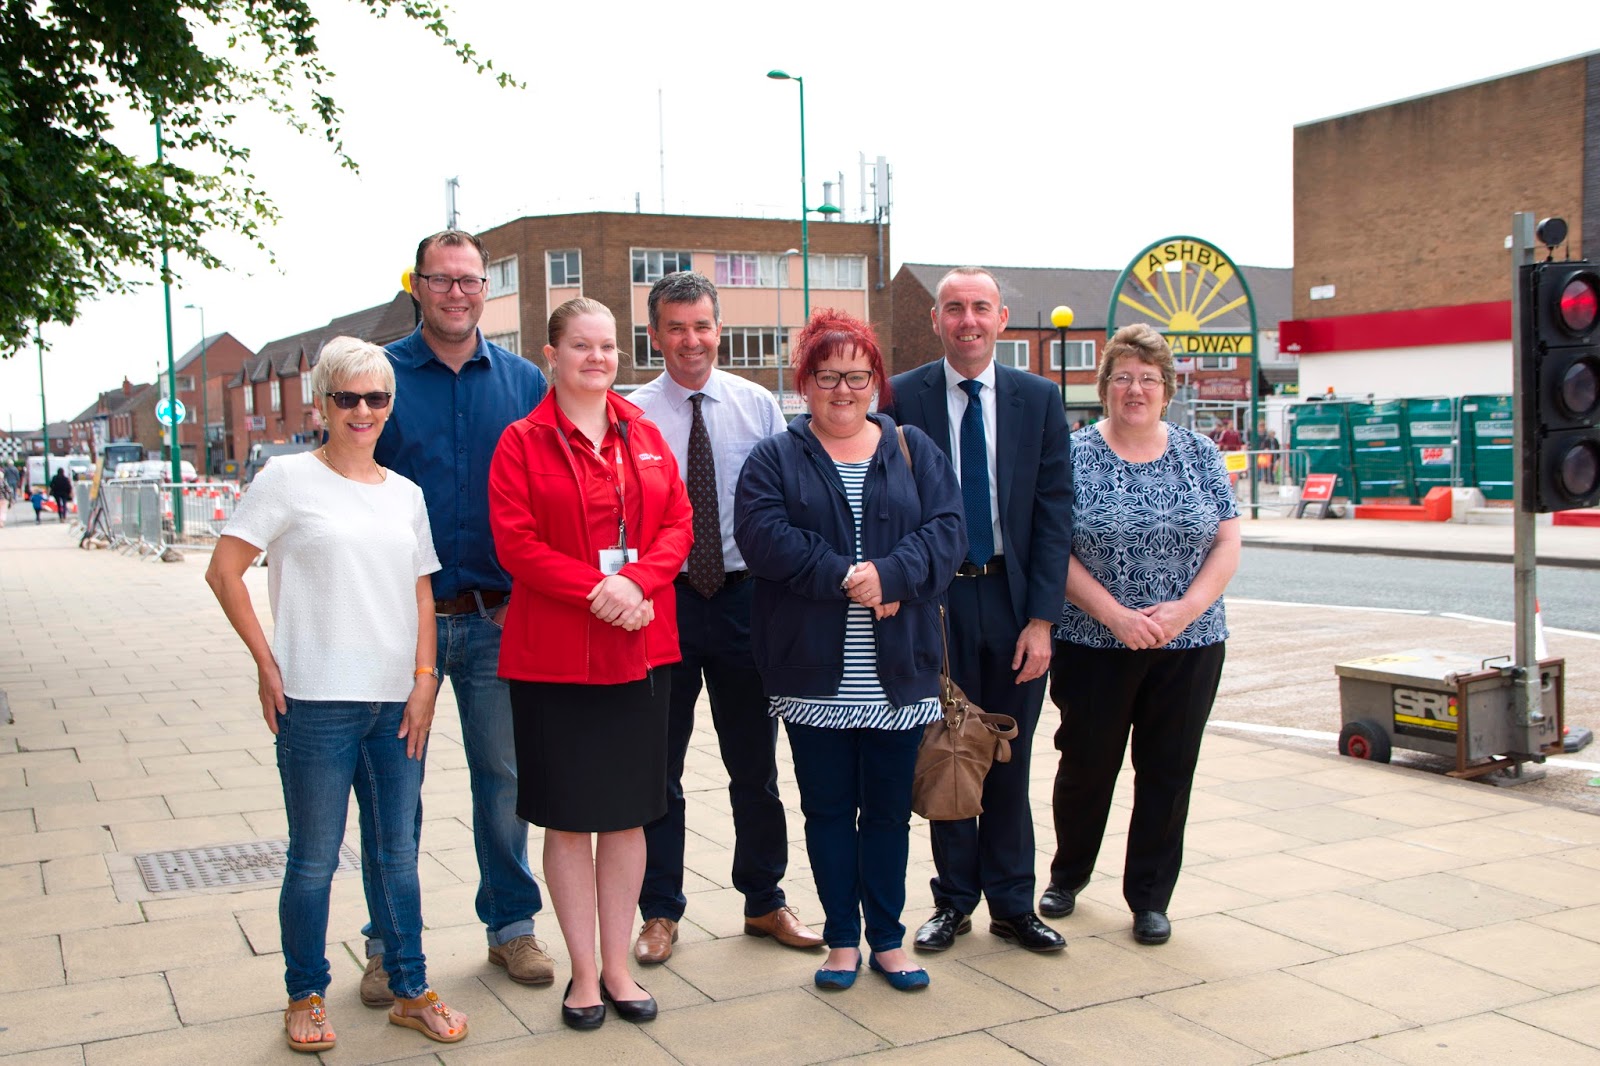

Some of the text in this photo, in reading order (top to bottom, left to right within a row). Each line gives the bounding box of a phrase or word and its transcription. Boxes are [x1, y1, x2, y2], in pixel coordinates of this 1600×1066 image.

[1149, 244, 1225, 272] ASHBY
[1164, 335, 1244, 353] ADWAY
[1394, 688, 1458, 723] SRL
